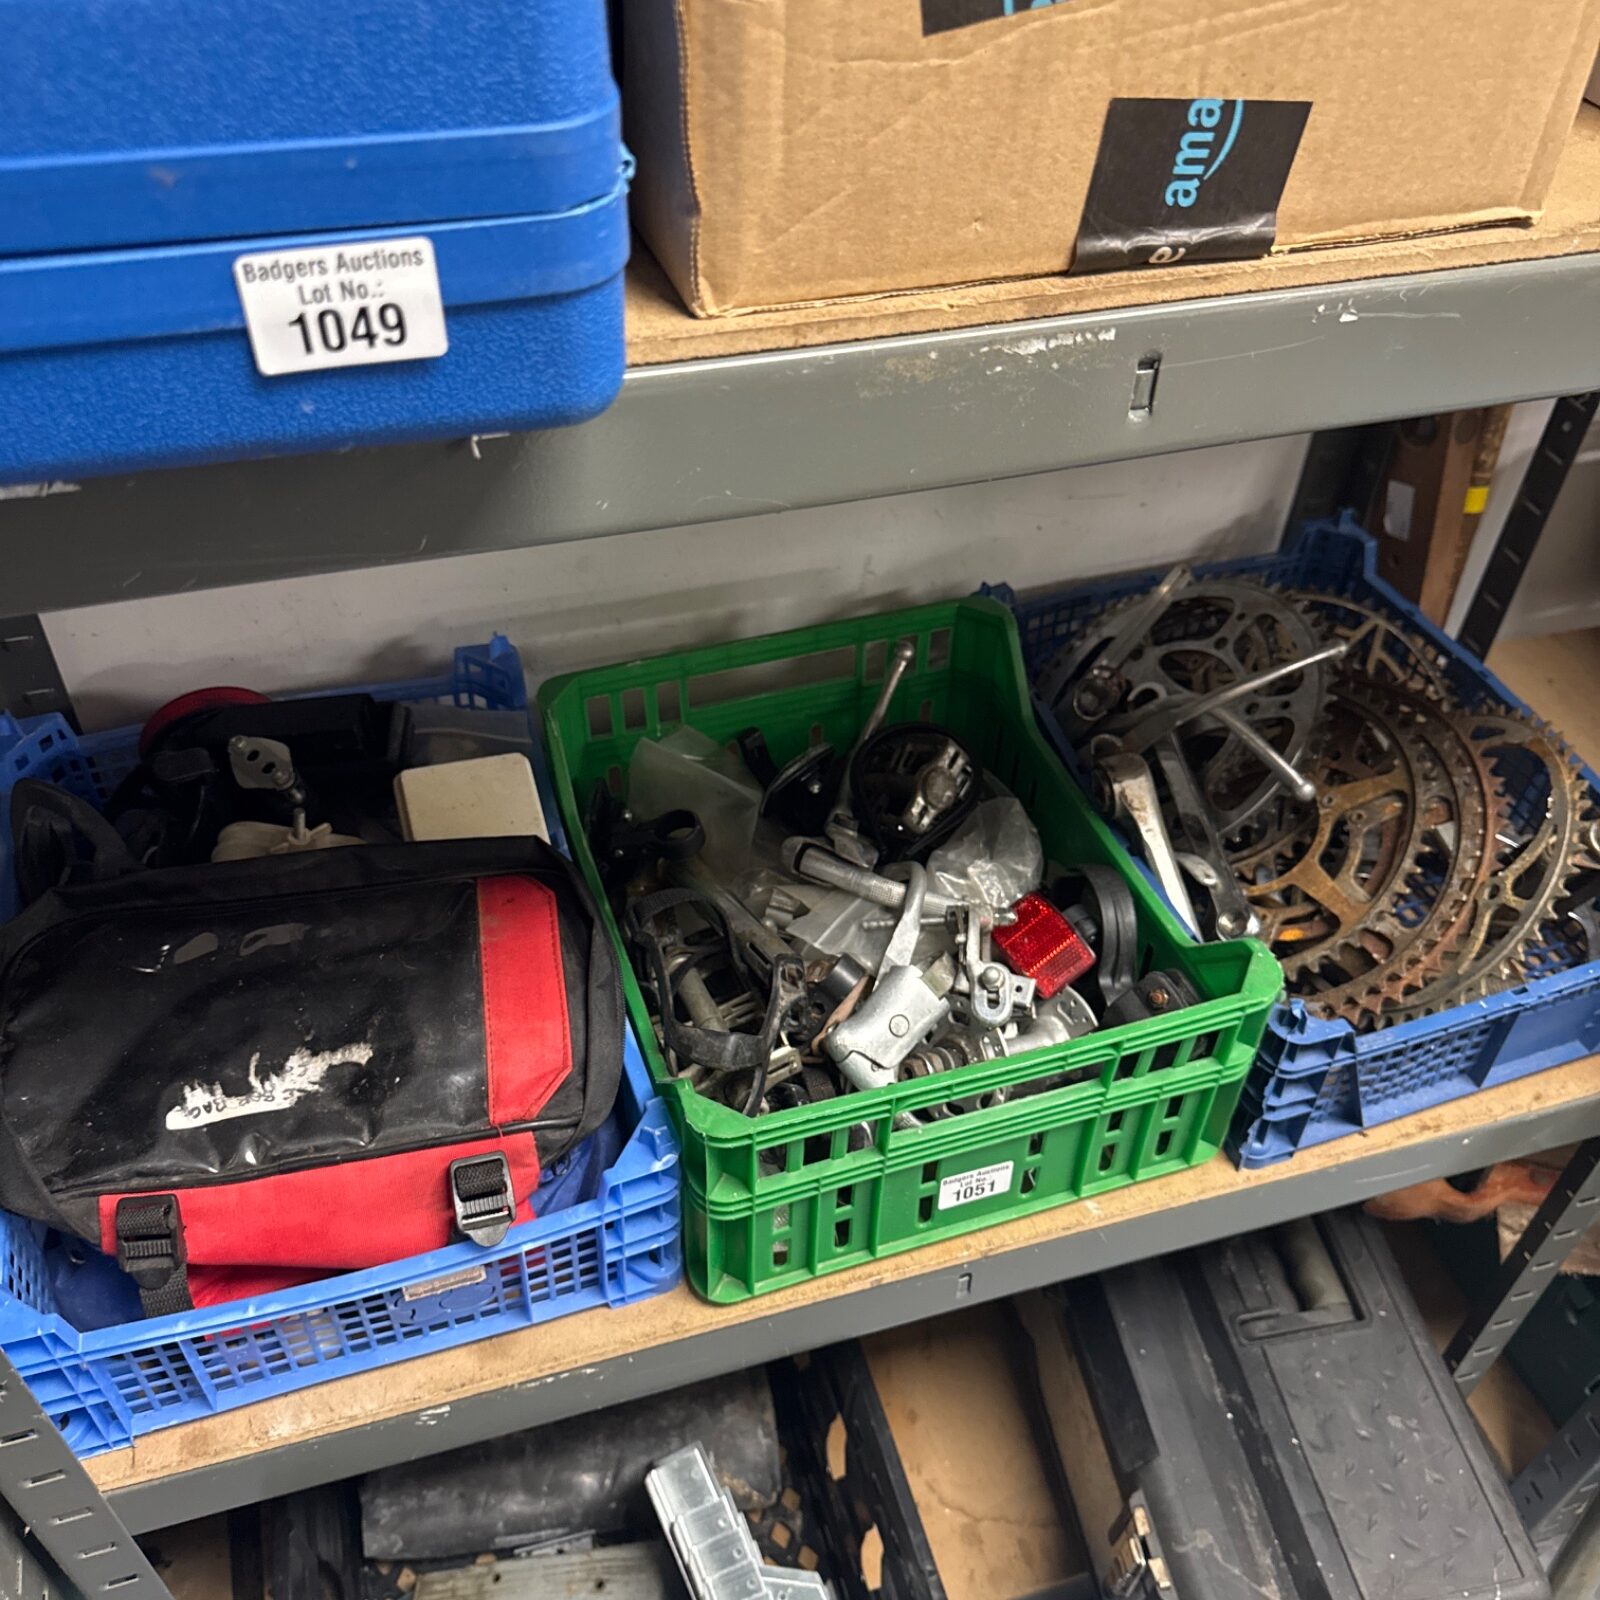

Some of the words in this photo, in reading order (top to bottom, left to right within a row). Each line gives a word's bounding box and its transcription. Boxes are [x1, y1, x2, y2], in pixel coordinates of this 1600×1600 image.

[1165, 98, 1224, 207] ama
[242, 258, 328, 283] Badgers
[336, 249, 424, 274] Auctions
[298, 284, 331, 306] Lot
[288, 302, 407, 355] 1049
[953, 1179, 995, 1201] 1051
